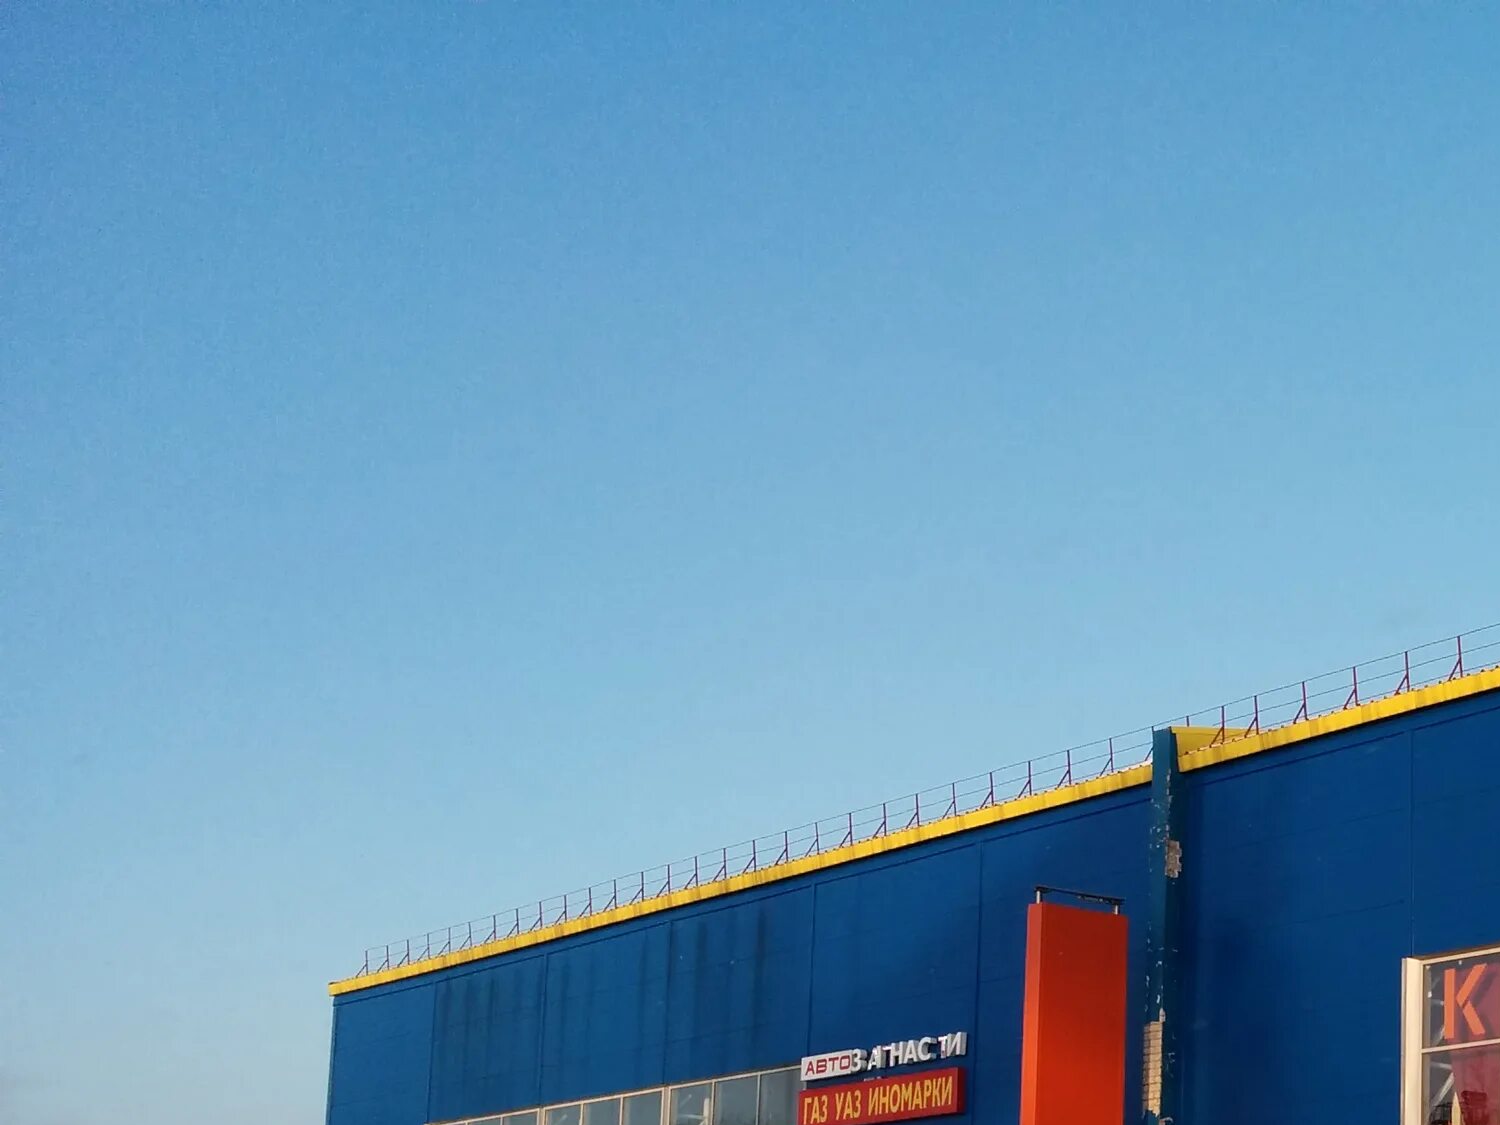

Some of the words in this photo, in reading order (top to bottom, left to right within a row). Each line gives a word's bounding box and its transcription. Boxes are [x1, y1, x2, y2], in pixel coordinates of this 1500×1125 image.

[803, 1095, 828, 1125] ГАЗ
[835, 1090, 861, 1121] УАЗ
[868, 1076, 953, 1116] ИНОМАРКИ
